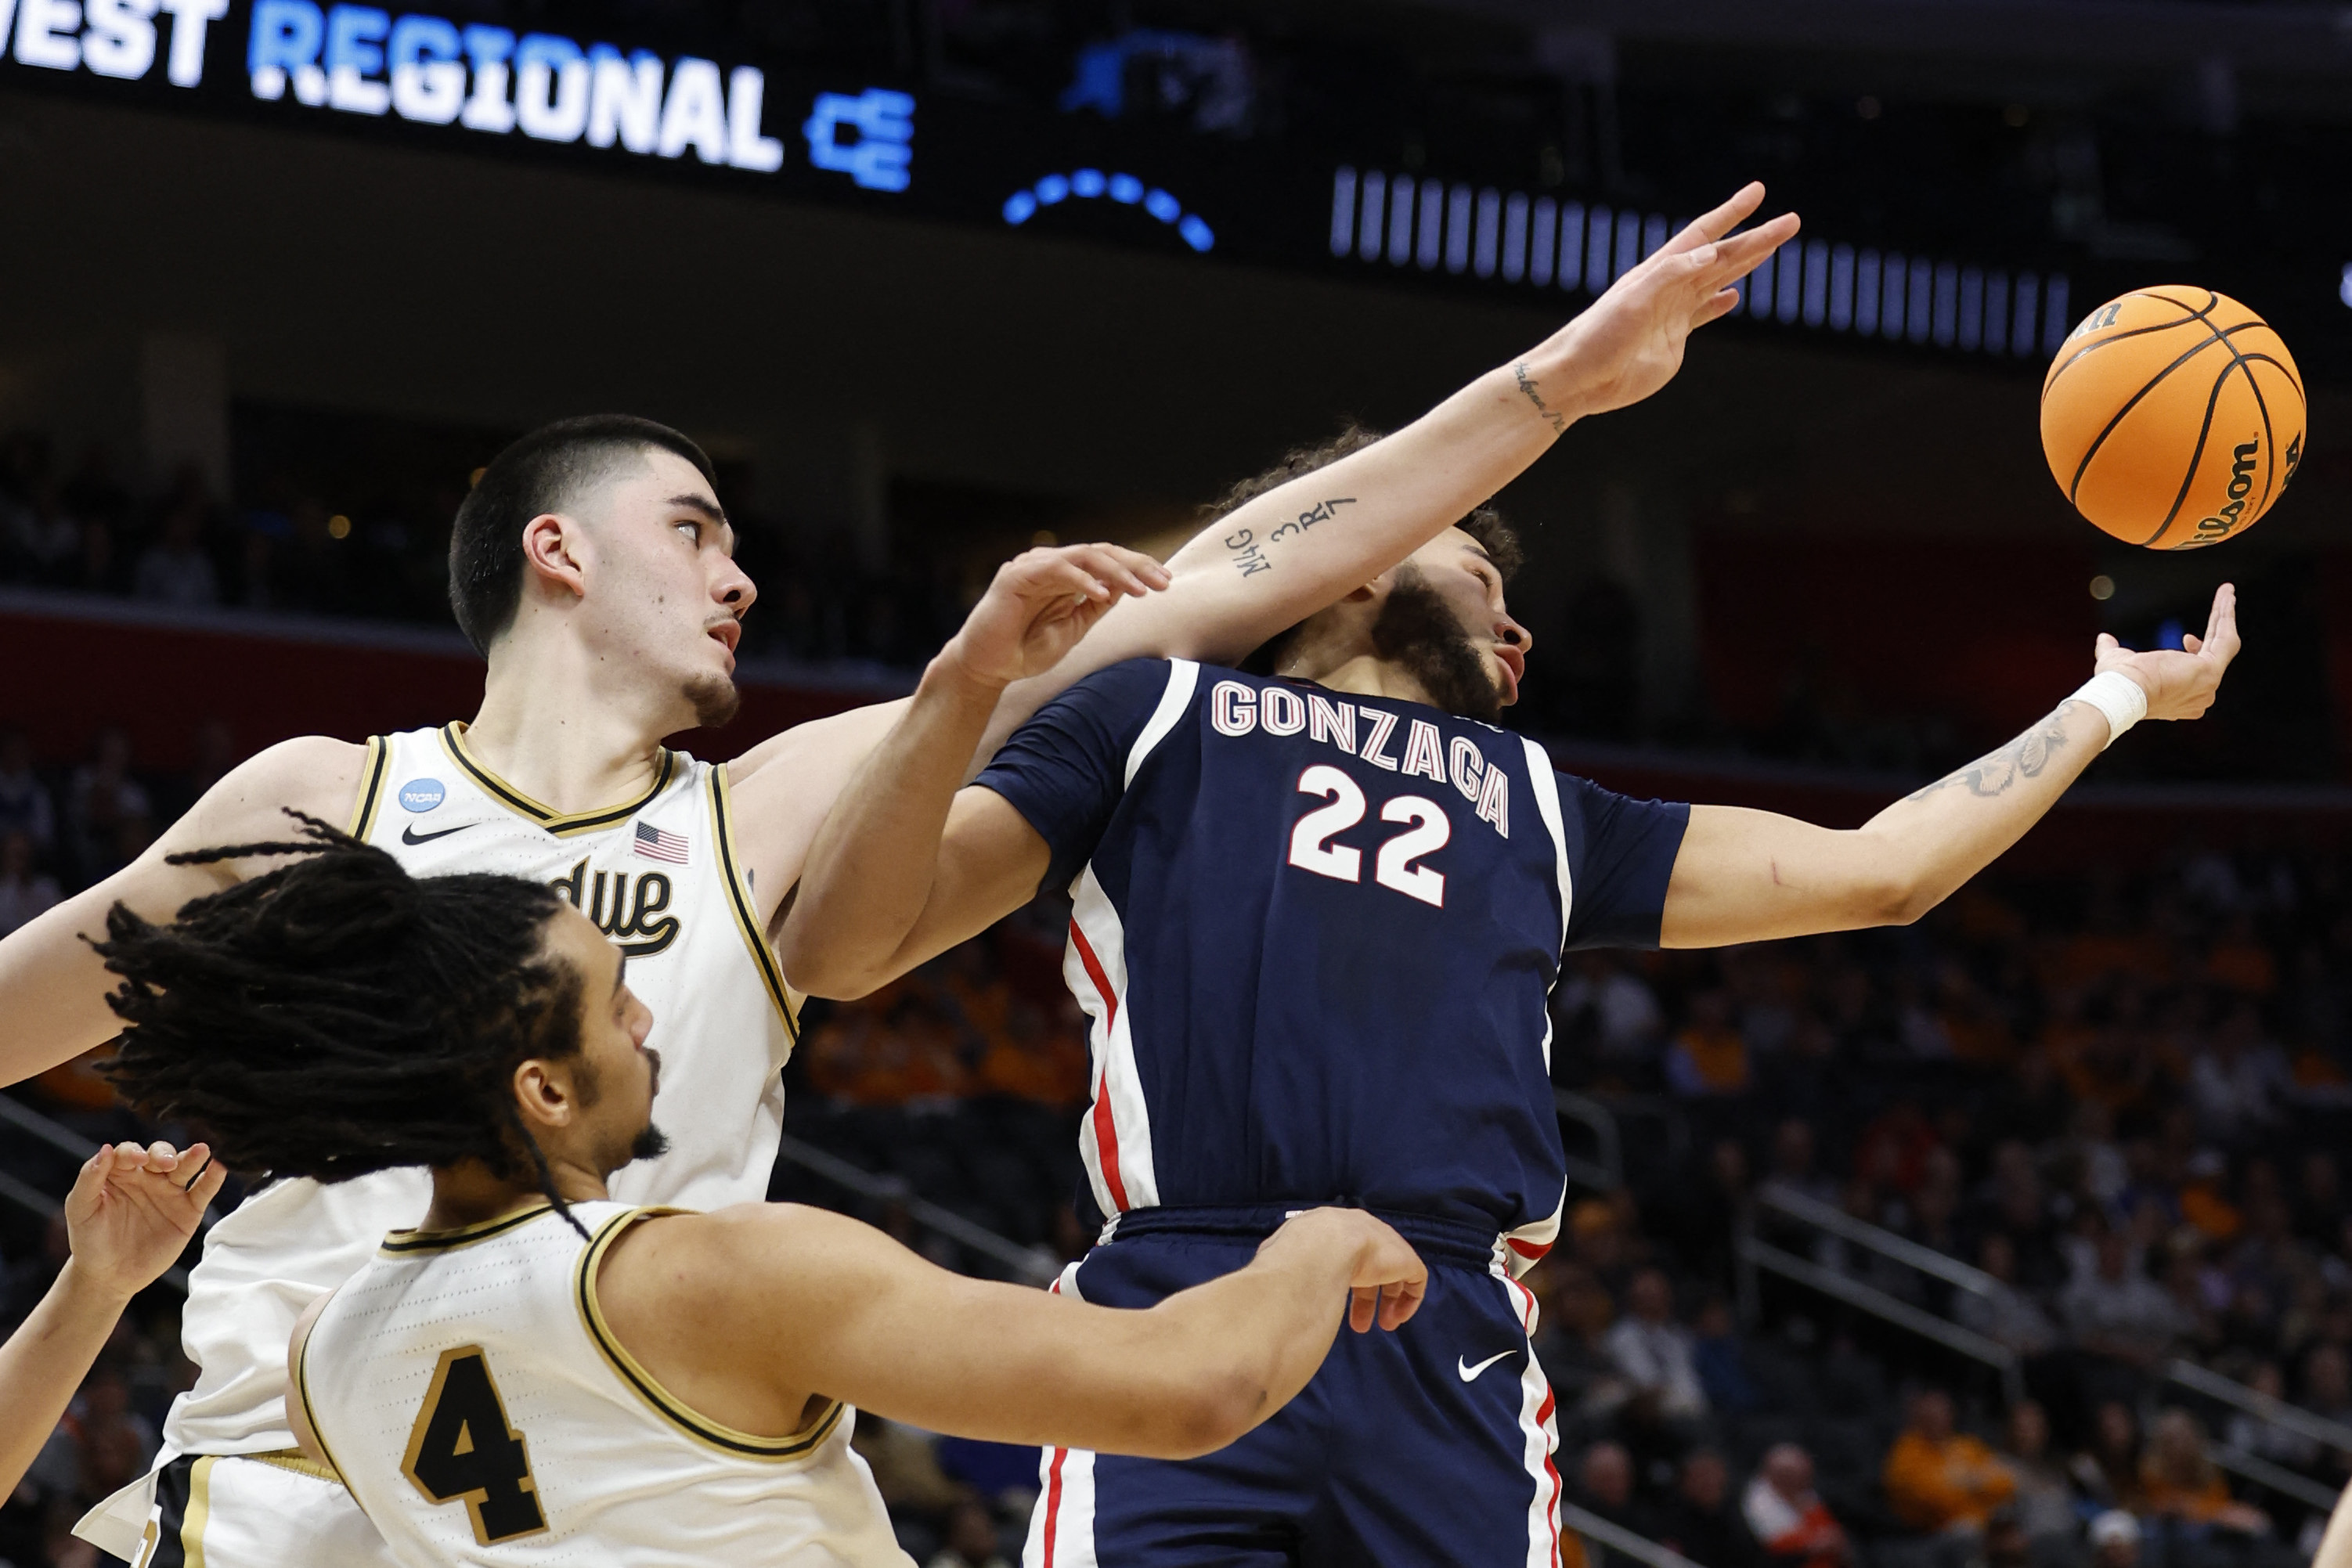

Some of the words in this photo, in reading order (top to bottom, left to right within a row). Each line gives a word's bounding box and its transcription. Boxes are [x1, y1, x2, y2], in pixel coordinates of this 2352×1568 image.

[0, 0, 230, 88] EST
[247, 0, 784, 173] REGIONAL
[403, 792, 442, 803] NCAA
[1211, 679, 1509, 839] GONZAGA
[1288, 763, 1452, 909] 22
[400, 1344, 550, 1547] 4
